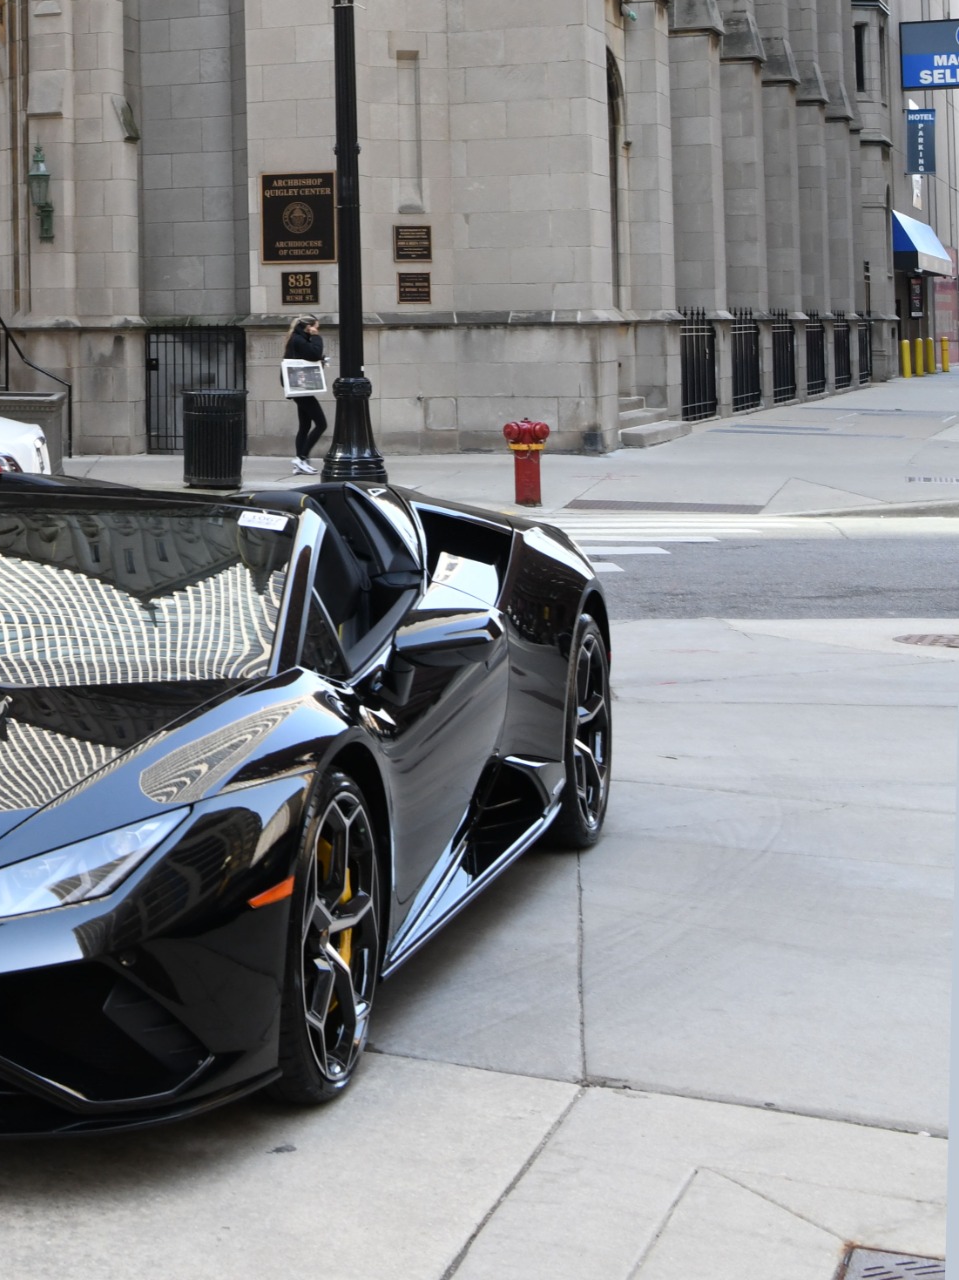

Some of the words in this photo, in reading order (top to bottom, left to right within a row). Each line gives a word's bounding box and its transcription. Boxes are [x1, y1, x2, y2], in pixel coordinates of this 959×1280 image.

[933, 54, 959, 66] MA
[919, 69, 959, 84] SEL
[272, 178, 323, 187] ARCHBISHOP
[264, 188, 298, 198] QUIGLEY
[299, 187, 332, 196] CENTER
[275, 240, 323, 248] ARCHDIOCESE
[289, 248, 319, 256] CHICAGO
[288, 273, 312, 287] 835
